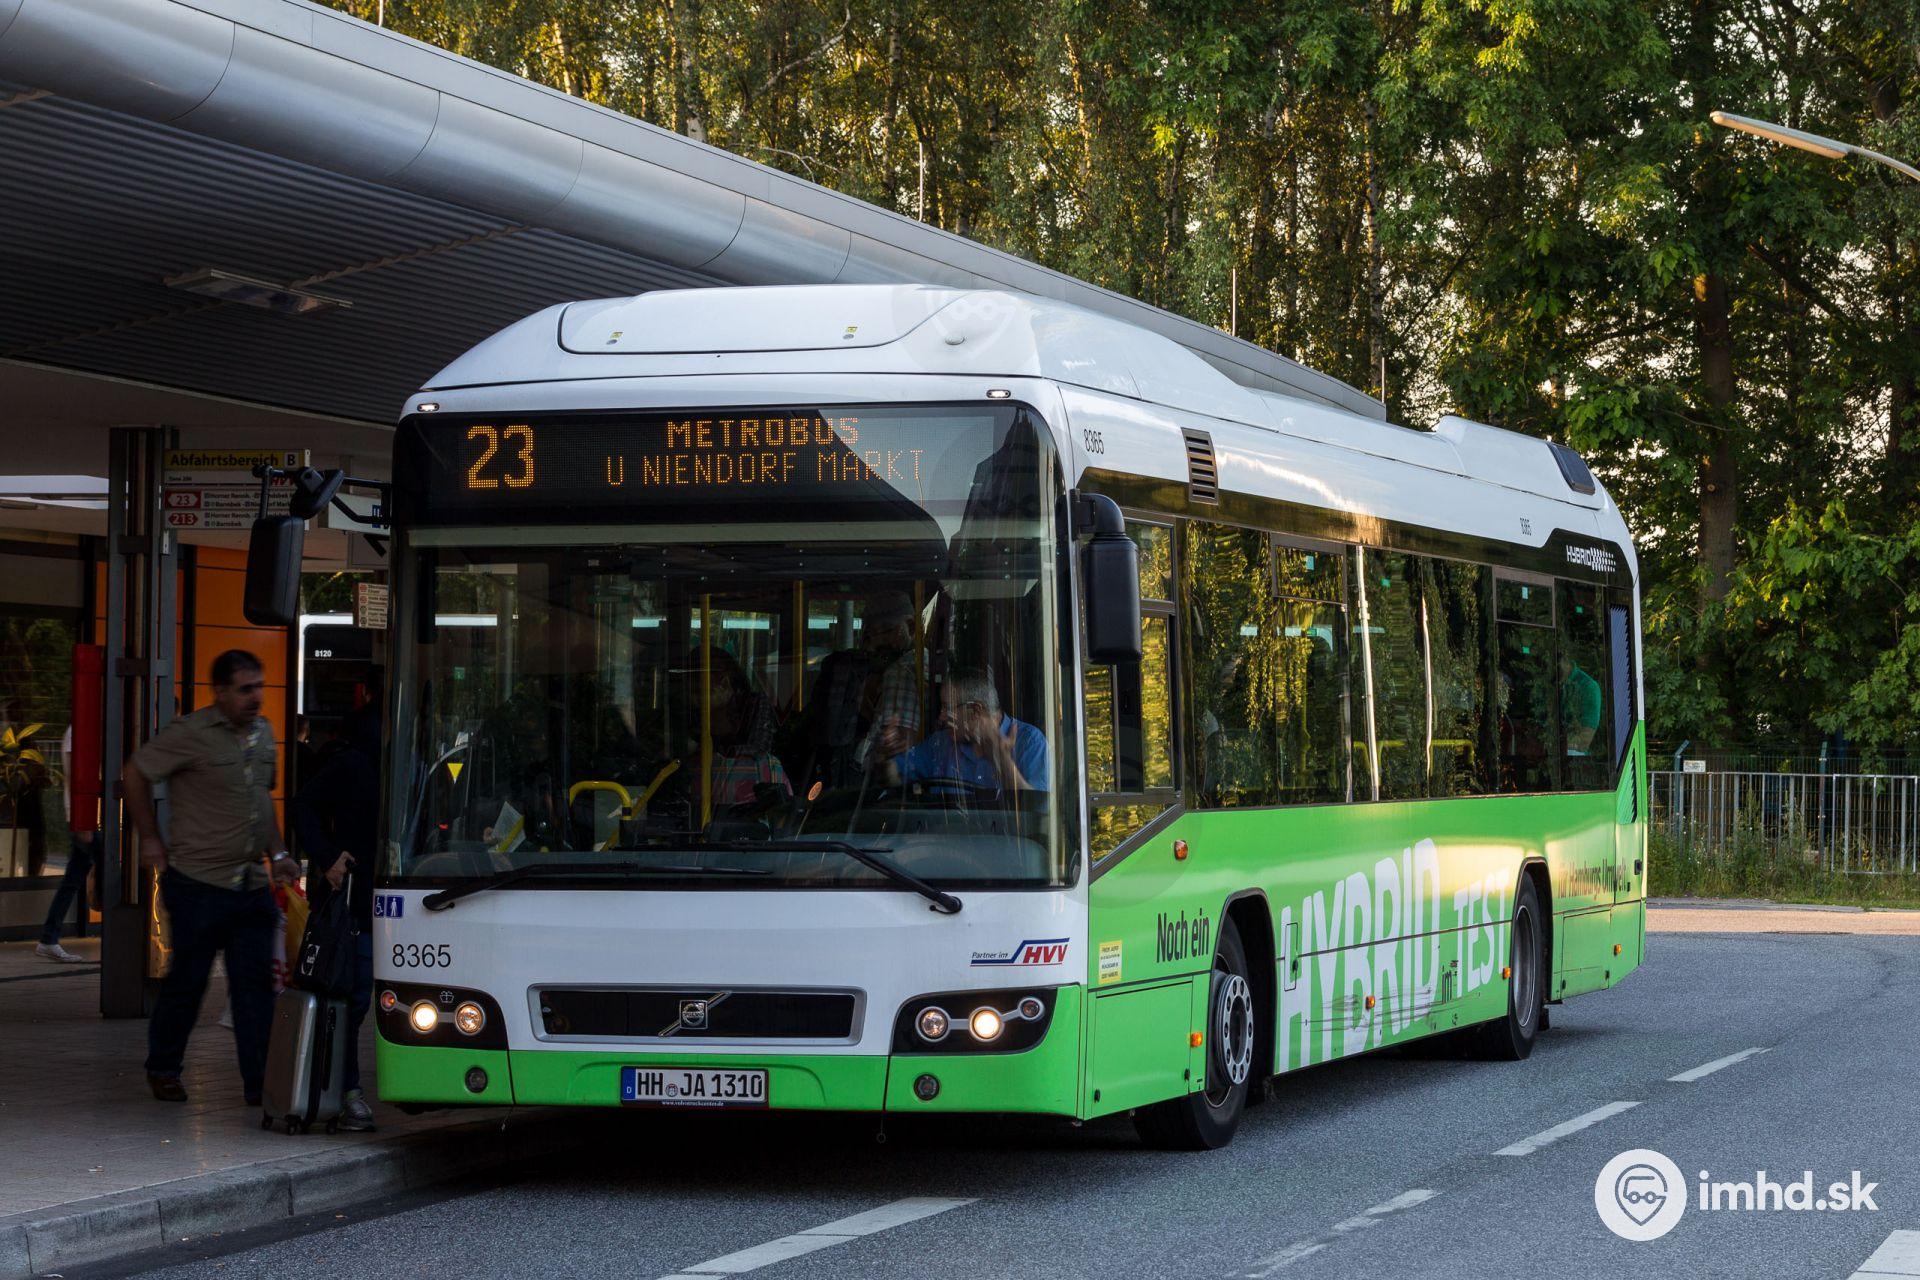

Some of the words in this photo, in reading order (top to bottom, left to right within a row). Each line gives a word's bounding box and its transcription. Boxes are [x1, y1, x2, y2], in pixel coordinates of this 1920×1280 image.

[667, 417, 859, 448] METROBUS
[1083, 428, 1105, 455] 8365
[170, 454, 279, 467] Abfahrtsbereich
[287, 454, 296, 466] B
[466, 425, 535, 488] 23
[607, 455, 625, 485] U
[643, 453, 796, 485] NIENDORF
[817, 449, 924, 481] MARKT
[176, 495, 190, 505] 23
[173, 514, 195, 525] 213
[1566, 544, 1592, 567] HYBRID
[315, 649, 332, 657] 8120
[1156, 910, 1188, 963] Noch
[1191, 908, 1210, 957] ein
[391, 943, 452, 968] 8365
[972, 951, 997, 959] Partner
[999, 951, 1009, 959] im
[1022, 944, 1068, 964] HVV
[1279, 838, 1440, 1075] HYBRID
[1454, 866, 1510, 999] TEST
[626, 1086, 633, 1095] D
[637, 1072, 664, 1096] HH
[680, 1073, 706, 1097] JA
[711, 1074, 763, 1098] 1310
